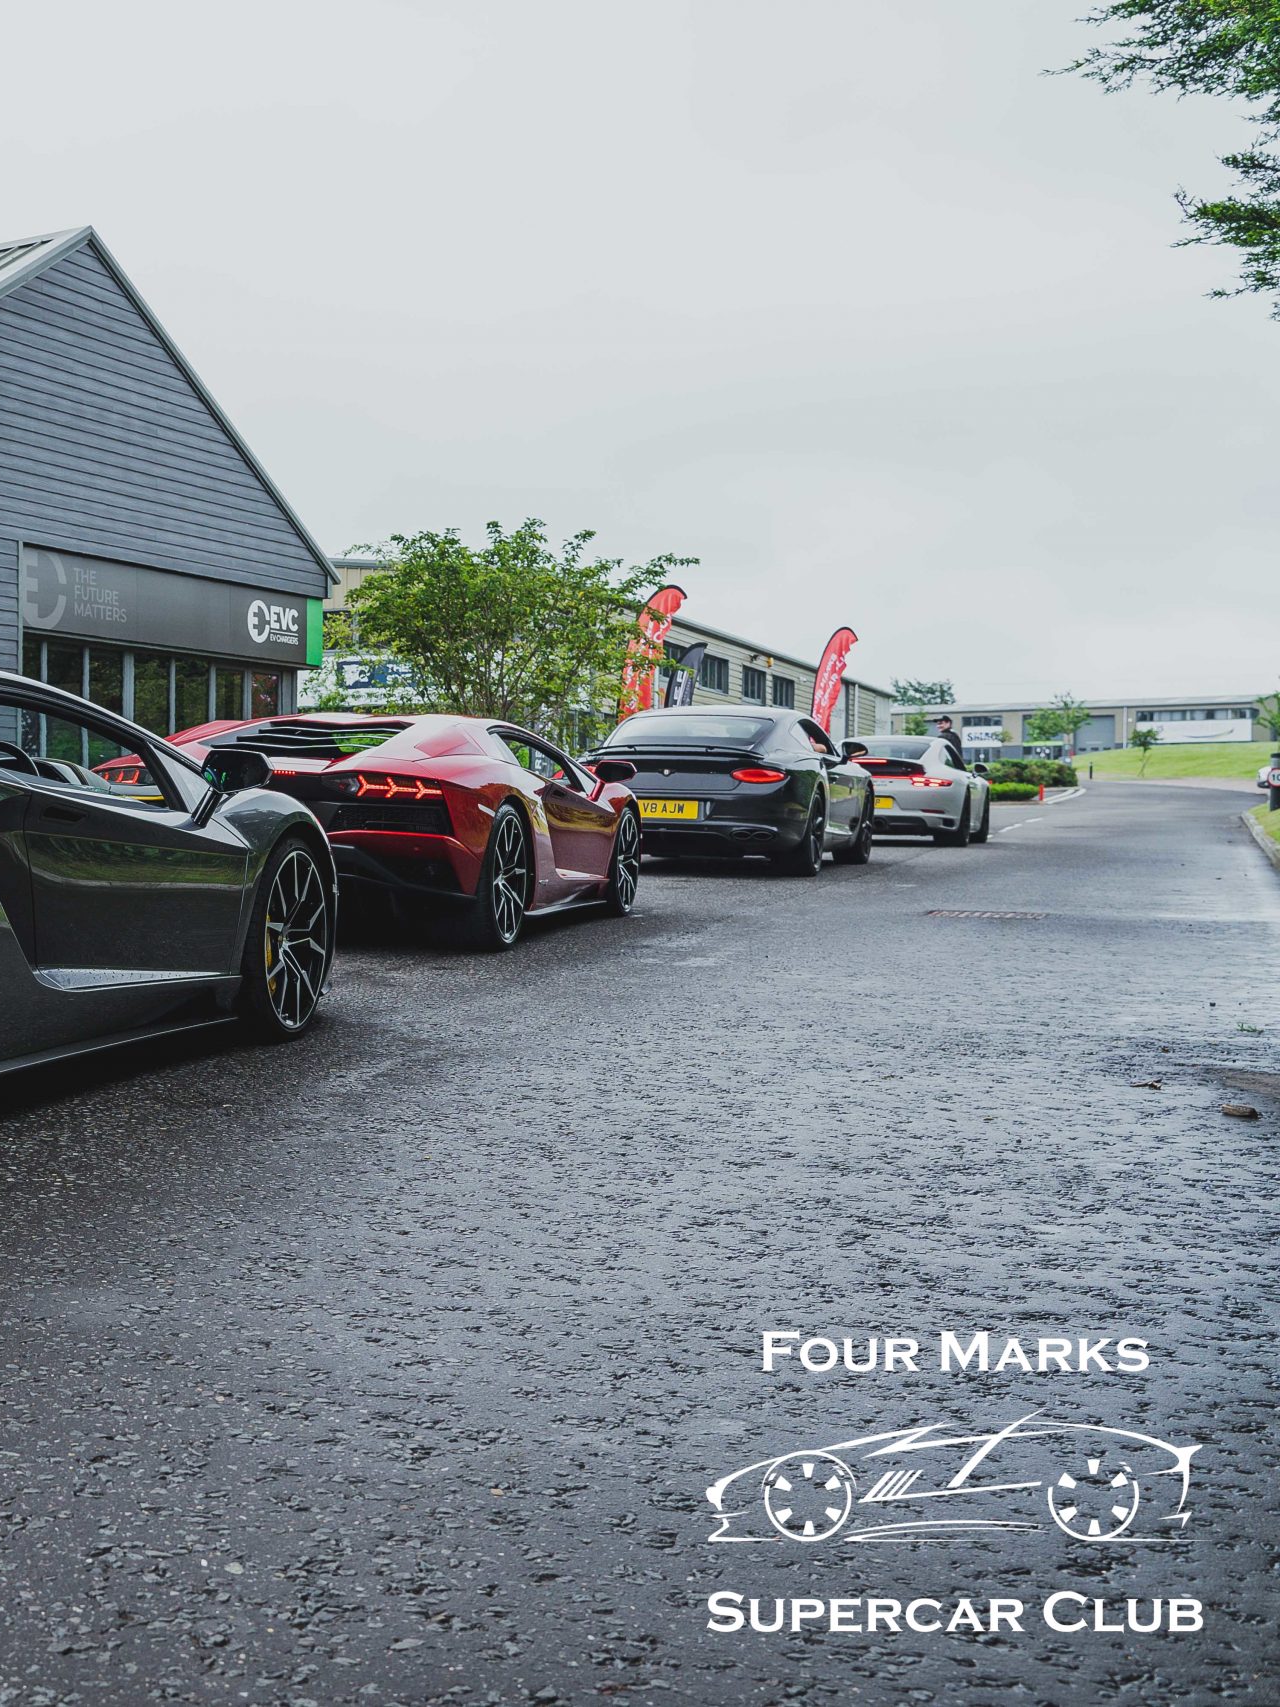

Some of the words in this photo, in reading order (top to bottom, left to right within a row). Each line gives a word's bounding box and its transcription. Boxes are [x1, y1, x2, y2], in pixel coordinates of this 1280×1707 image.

[74, 567, 97, 585] THE
[74, 585, 120, 605] FUTURE
[74, 601, 127, 623] MATTERS
[270, 605, 299, 632] EVC
[642, 802, 657, 813] V8
[661, 803, 685, 814] AJW
